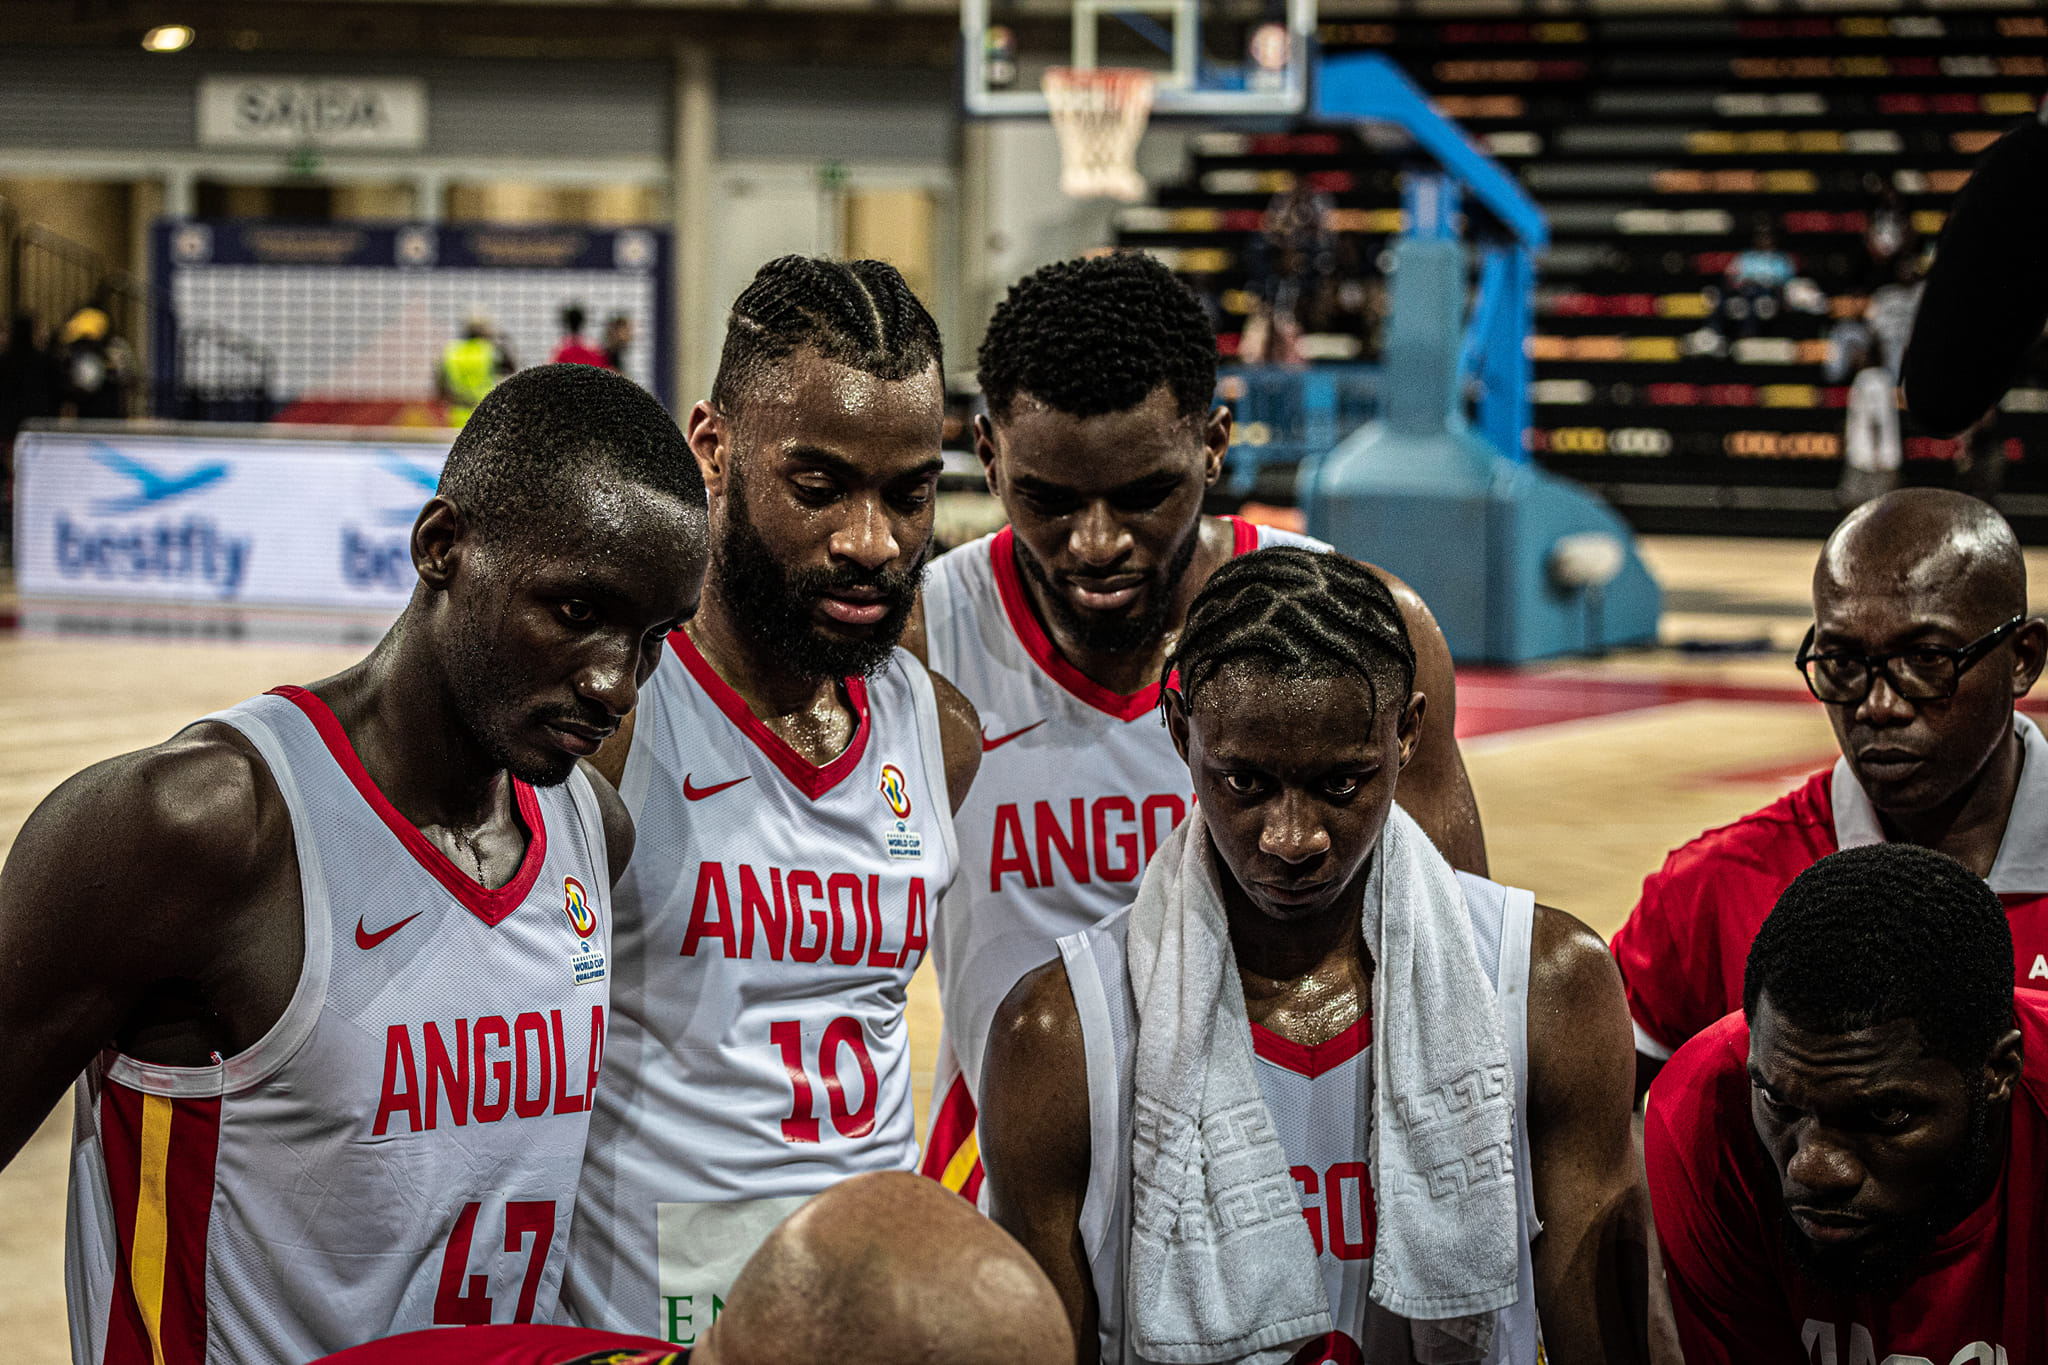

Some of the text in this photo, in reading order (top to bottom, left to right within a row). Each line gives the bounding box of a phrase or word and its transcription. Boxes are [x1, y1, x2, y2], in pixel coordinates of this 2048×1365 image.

[55, 511, 252, 598] bestfly
[889, 839, 920, 848] WORLD CUP
[890, 848, 921, 856] QUALIFIERS
[680, 861, 928, 968] ANGOLA
[574, 957, 604, 972] WORLD CUP
[576, 969, 605, 982] QUALIFIERS
[372, 1005, 604, 1136] ANGOLA
[770, 1016, 878, 1143] 10
[433, 1200, 556, 1325] 47
[662, 1294, 728, 1344] E
